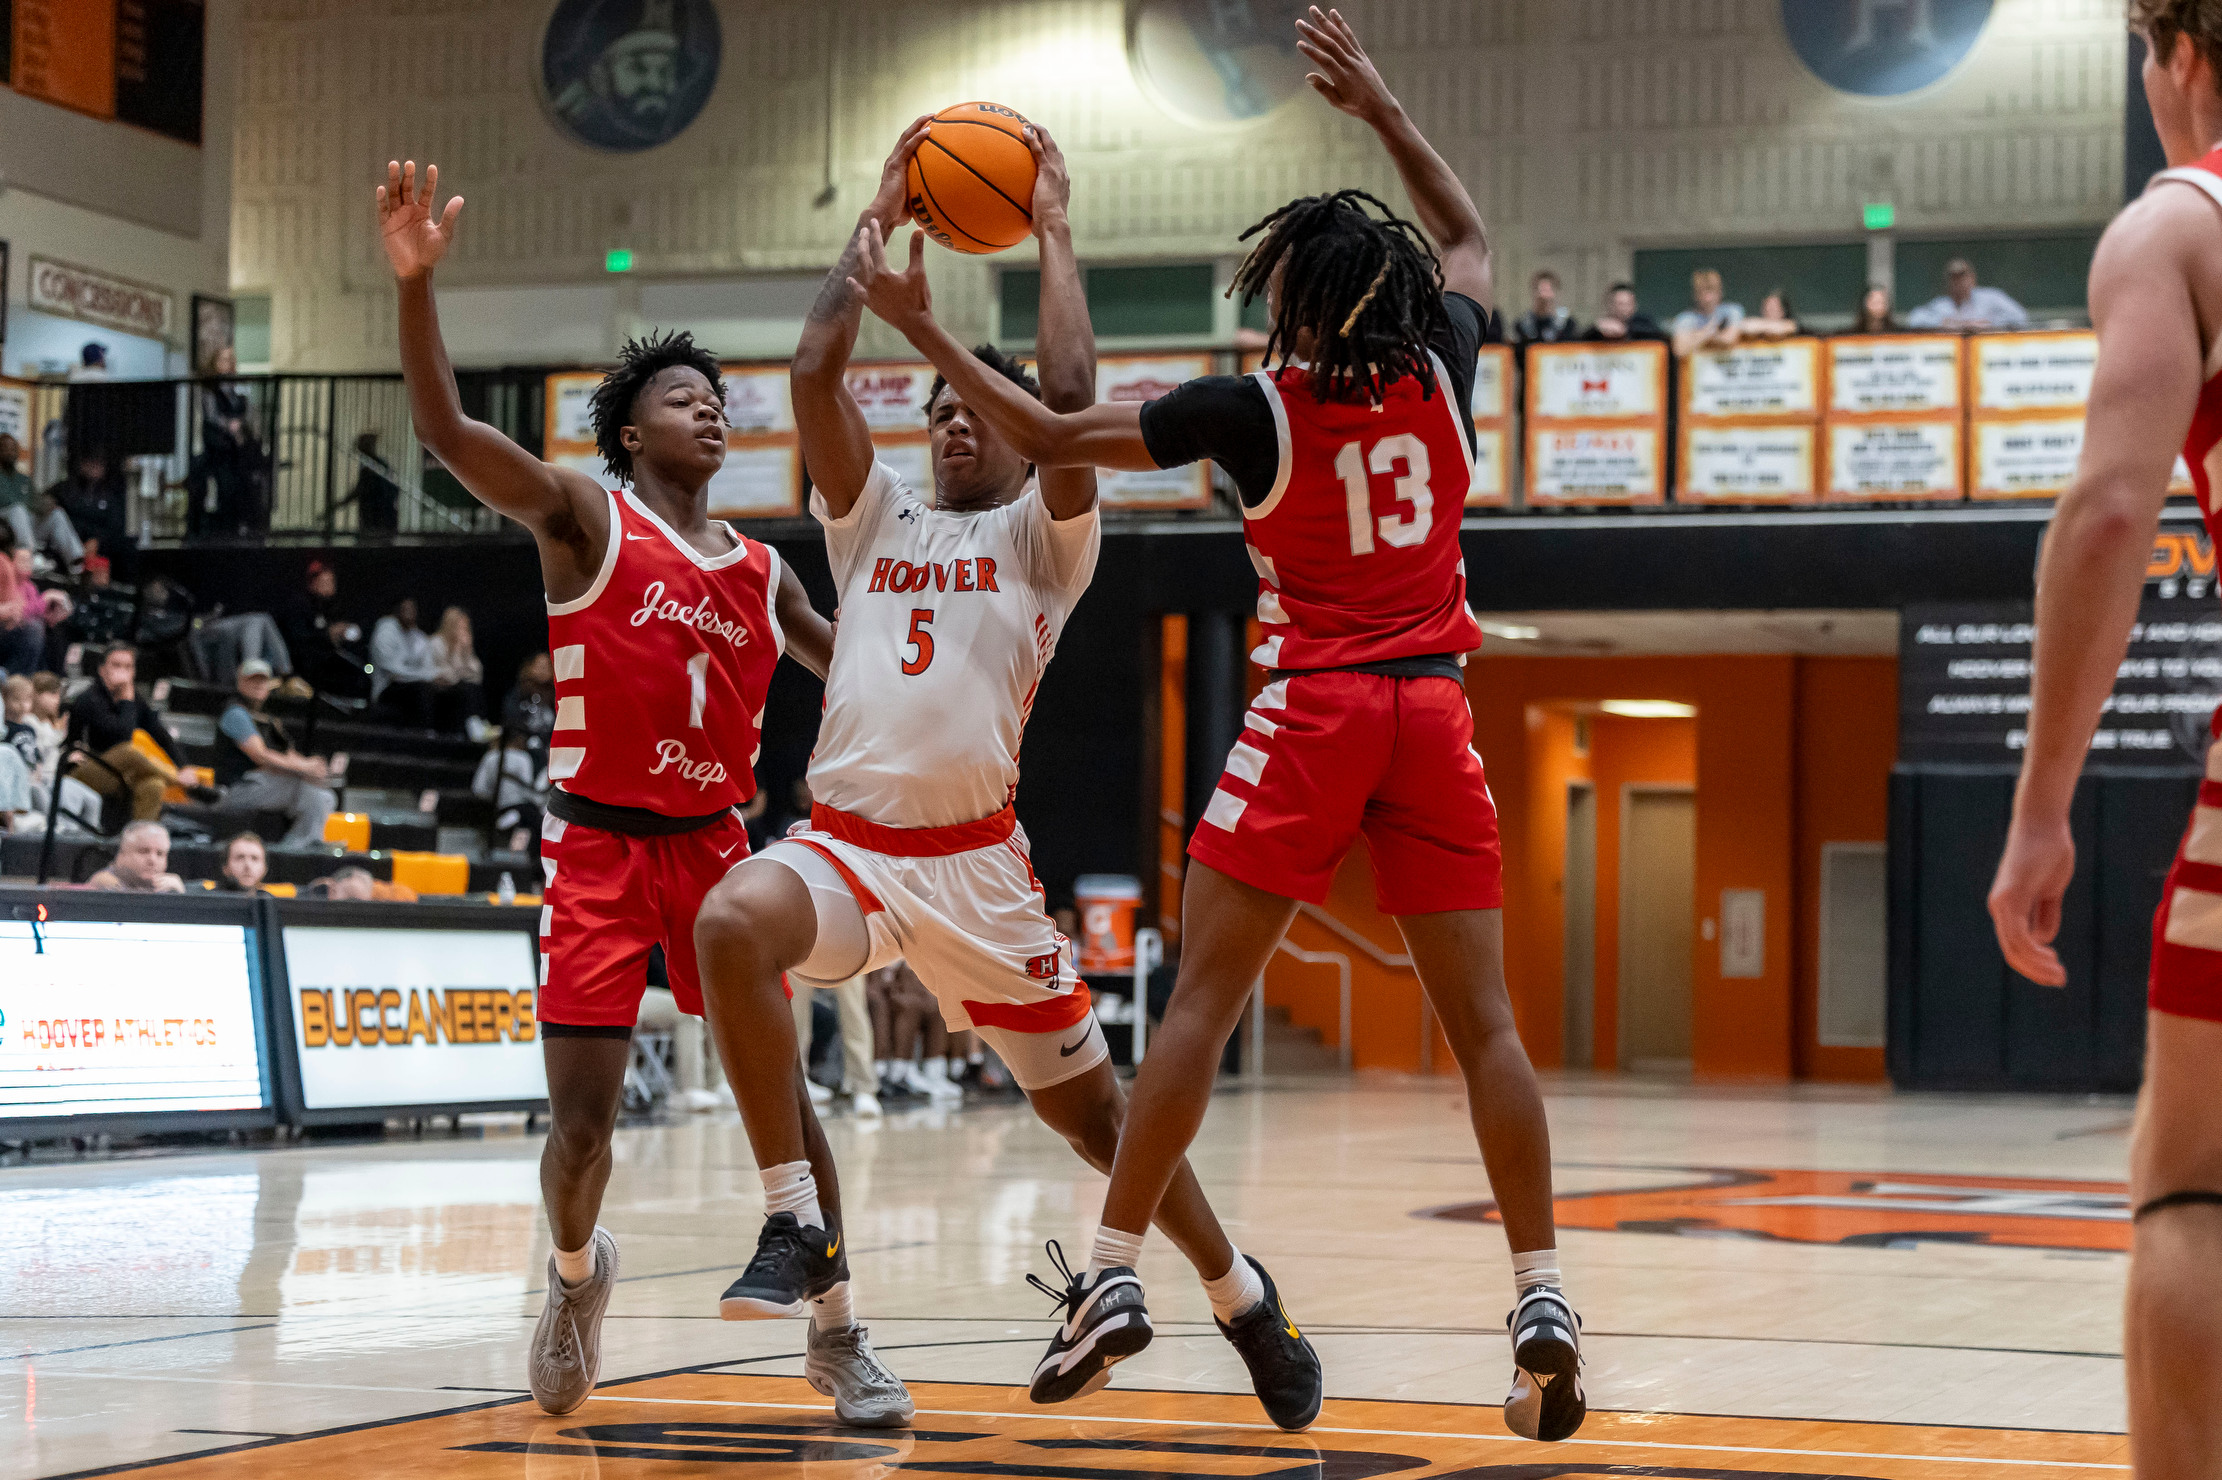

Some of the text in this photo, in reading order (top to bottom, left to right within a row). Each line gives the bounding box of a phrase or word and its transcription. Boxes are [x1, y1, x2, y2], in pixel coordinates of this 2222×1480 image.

[1333, 432, 1435, 557] 13
[866, 557, 1001, 594] HOOVER
[629, 580, 749, 648] Jackson
[900, 608, 935, 677] 5
[686, 651, 710, 730] 1
[648, 738, 727, 791] Prep
[22, 1018, 104, 1049] HOOVER
[114, 1018, 217, 1046] ATHLETCS
[300, 988, 537, 1048] BUCCANEERS
